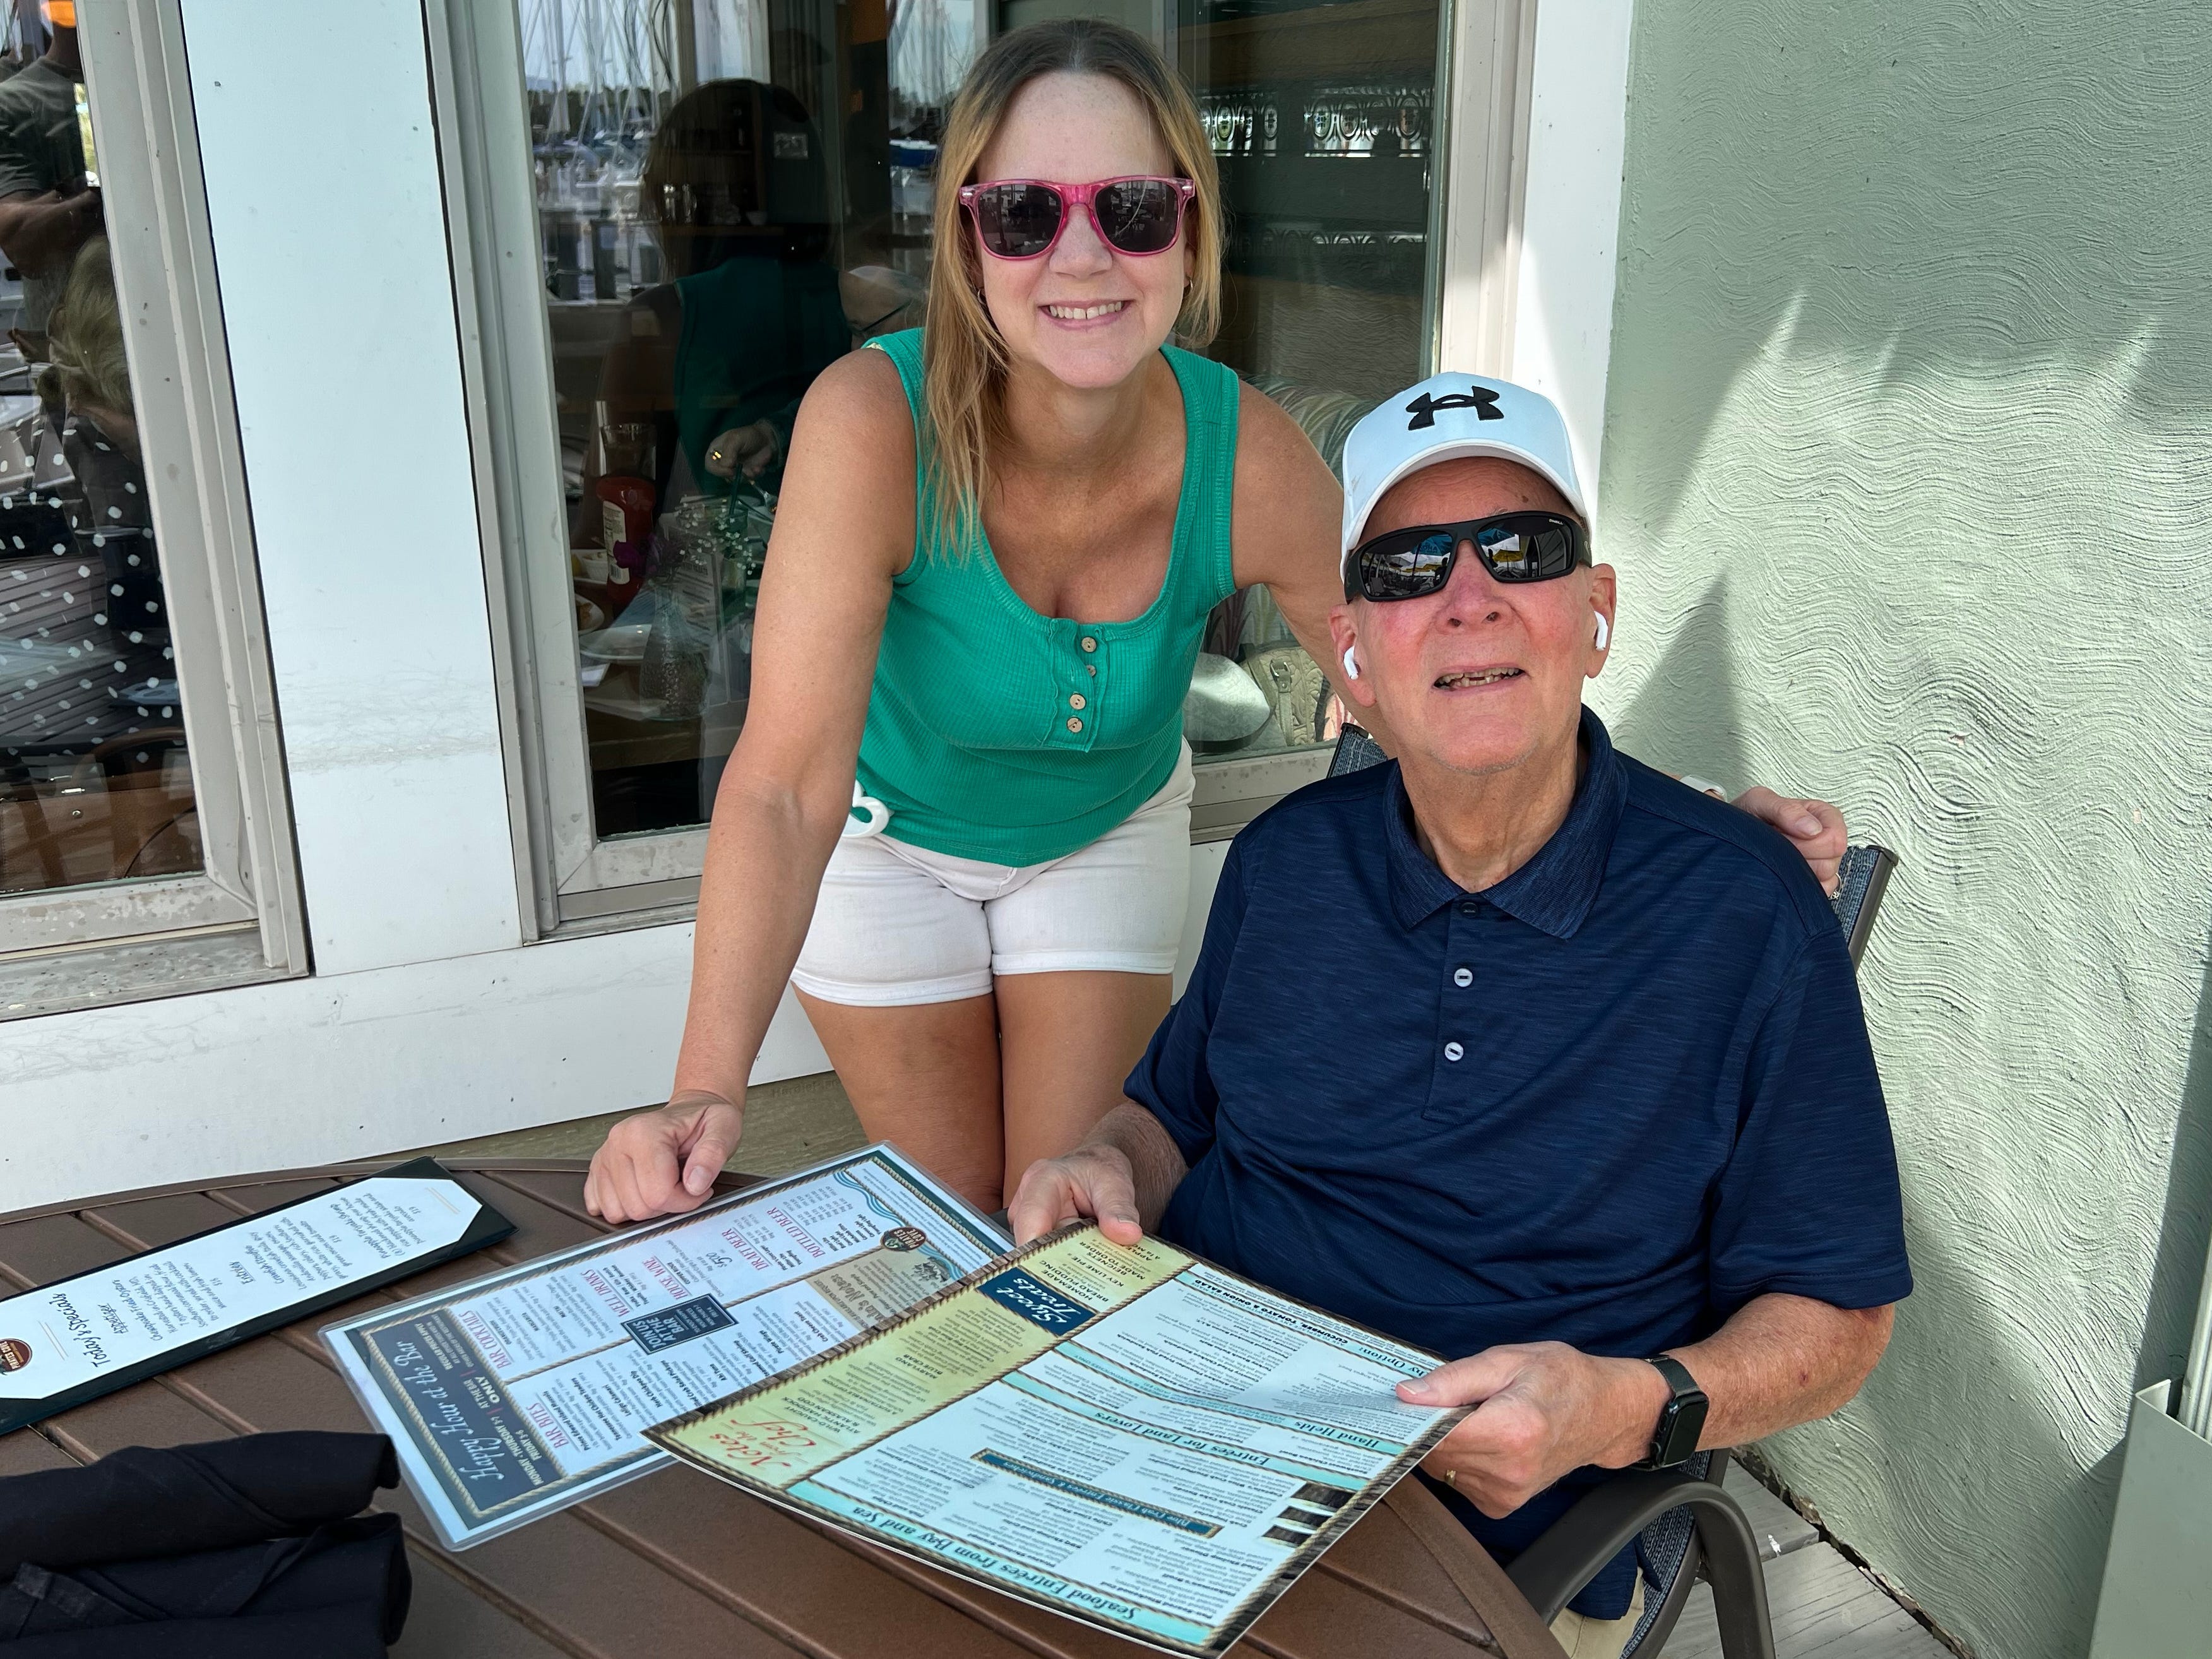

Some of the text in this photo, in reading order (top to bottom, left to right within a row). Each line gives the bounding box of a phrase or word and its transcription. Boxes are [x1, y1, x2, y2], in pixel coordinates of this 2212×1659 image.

[766, 1207, 825, 1257] BOTTLED BEER
[894, 1229, 919, 1247] PIRATES
[907, 1228, 924, 1241] COVE
[722, 1228, 768, 1270] DRAFT BEER
[1079, 1241, 1107, 1258] ORDER
[148, 1263, 166, 1275] fried
[163, 1261, 183, 1278] cocktail
[183, 1263, 198, 1278] lemon
[229, 1261, 253, 1284] Entrées
[1071, 1256, 1124, 1287] KEY LIME PIE
[1087, 1252, 1126, 1275] BEIGNETS
[1119, 1266, 1145, 1279] MADE
[177, 1278, 191, 1288] with
[643, 1257, 687, 1299] HOUSE WINE
[831, 1273, 864, 1301] Notes:
[1040, 1260, 1109, 1301] BREAD PUDDING
[1042, 1270, 1092, 1300] HOMEMADE
[1195, 1280, 1222, 1292] SALAD
[200, 1287, 215, 1296] and
[581, 1269, 629, 1316] WELL DRINKS
[1013, 1278, 1090, 1316] Treats
[1223, 1292, 1251, 1305] ONION
[112, 1280, 162, 1340] Chesapeake Fried Oysters
[996, 1287, 1066, 1322] Sweet
[1261, 1308, 1296, 1323] TOMATO
[98, 1303, 128, 1333] Appetizer
[187, 1307, 208, 1327] Southern
[646, 1317, 675, 1340] AT THE
[663, 1317, 684, 1333] BAR
[794, 1311, 828, 1341] Crab Cheese Toast
[49, 1293, 110, 1367] Today's Specials
[460, 1311, 511, 1368] BAR COCKTAILS
[633, 1320, 666, 1347] JOIN US
[759, 1330, 784, 1353] Pirate Wings
[1301, 1323, 1347, 1343] CUCUMBER,
[415, 1323, 453, 1369] REGULAR PRICES APPLY
[734, 1340, 748, 1353] Shrimp
[1359, 1347, 1405, 1367] Option:
[896, 1357, 937, 1379] MARYLAND
[903, 1353, 942, 1374] BLUE CRAB
[1193, 1352, 1216, 1364] Chicken
[475, 1376, 499, 1403] ONLY
[630, 1371, 662, 1407] Herb Chickpea Dip
[672, 1375, 686, 1387] Salad
[682, 1386, 694, 1396] Crab
[463, 1378, 490, 1408] AT THE BAR
[602, 1384, 631, 1416] Loligo Calamari
[797, 1397, 815, 1406] COD
[394, 1341, 504, 1479] Happy Hour at the Bar
[553, 1406, 568, 1420] Island
[571, 1377, 622, 1440] Tennessee Hot Chicken Tenders
[782, 1396, 821, 1416] HADDOCK
[814, 1405, 852, 1422] ALASKAN
[491, 1416, 502, 1425] 3-7
[526, 1403, 569, 1448] BAR BITES
[563, 1420, 580, 1436] Edward
[784, 1406, 840, 1432] WILD-CAUGHT
[821, 1415, 860, 1433] ATLANTIC
[495, 1425, 522, 1456] THURSDAY
[578, 1436, 590, 1450] Prince
[730, 1419, 816, 1446] Chef
[735, 1430, 801, 1455] from the
[1091, 1410, 1270, 1465] Entrées for Land Lovers
[1296, 1422, 1379, 1447] Hand Helds
[515, 1429, 541, 1460] FRIDAY 3-6
[710, 1433, 790, 1466] Notes
[518, 1458, 543, 1485] MONDAY
[999, 1462, 1056, 1484] Sandwiches
[1063, 1483, 1104, 1500] Entrées
[1103, 1495, 1141, 1509] Classic
[1136, 1506, 1167, 1519] Crab
[1165, 1516, 1191, 1526] Blue
[853, 1507, 1134, 1619] Seafood Entrées from Bay and Sea
